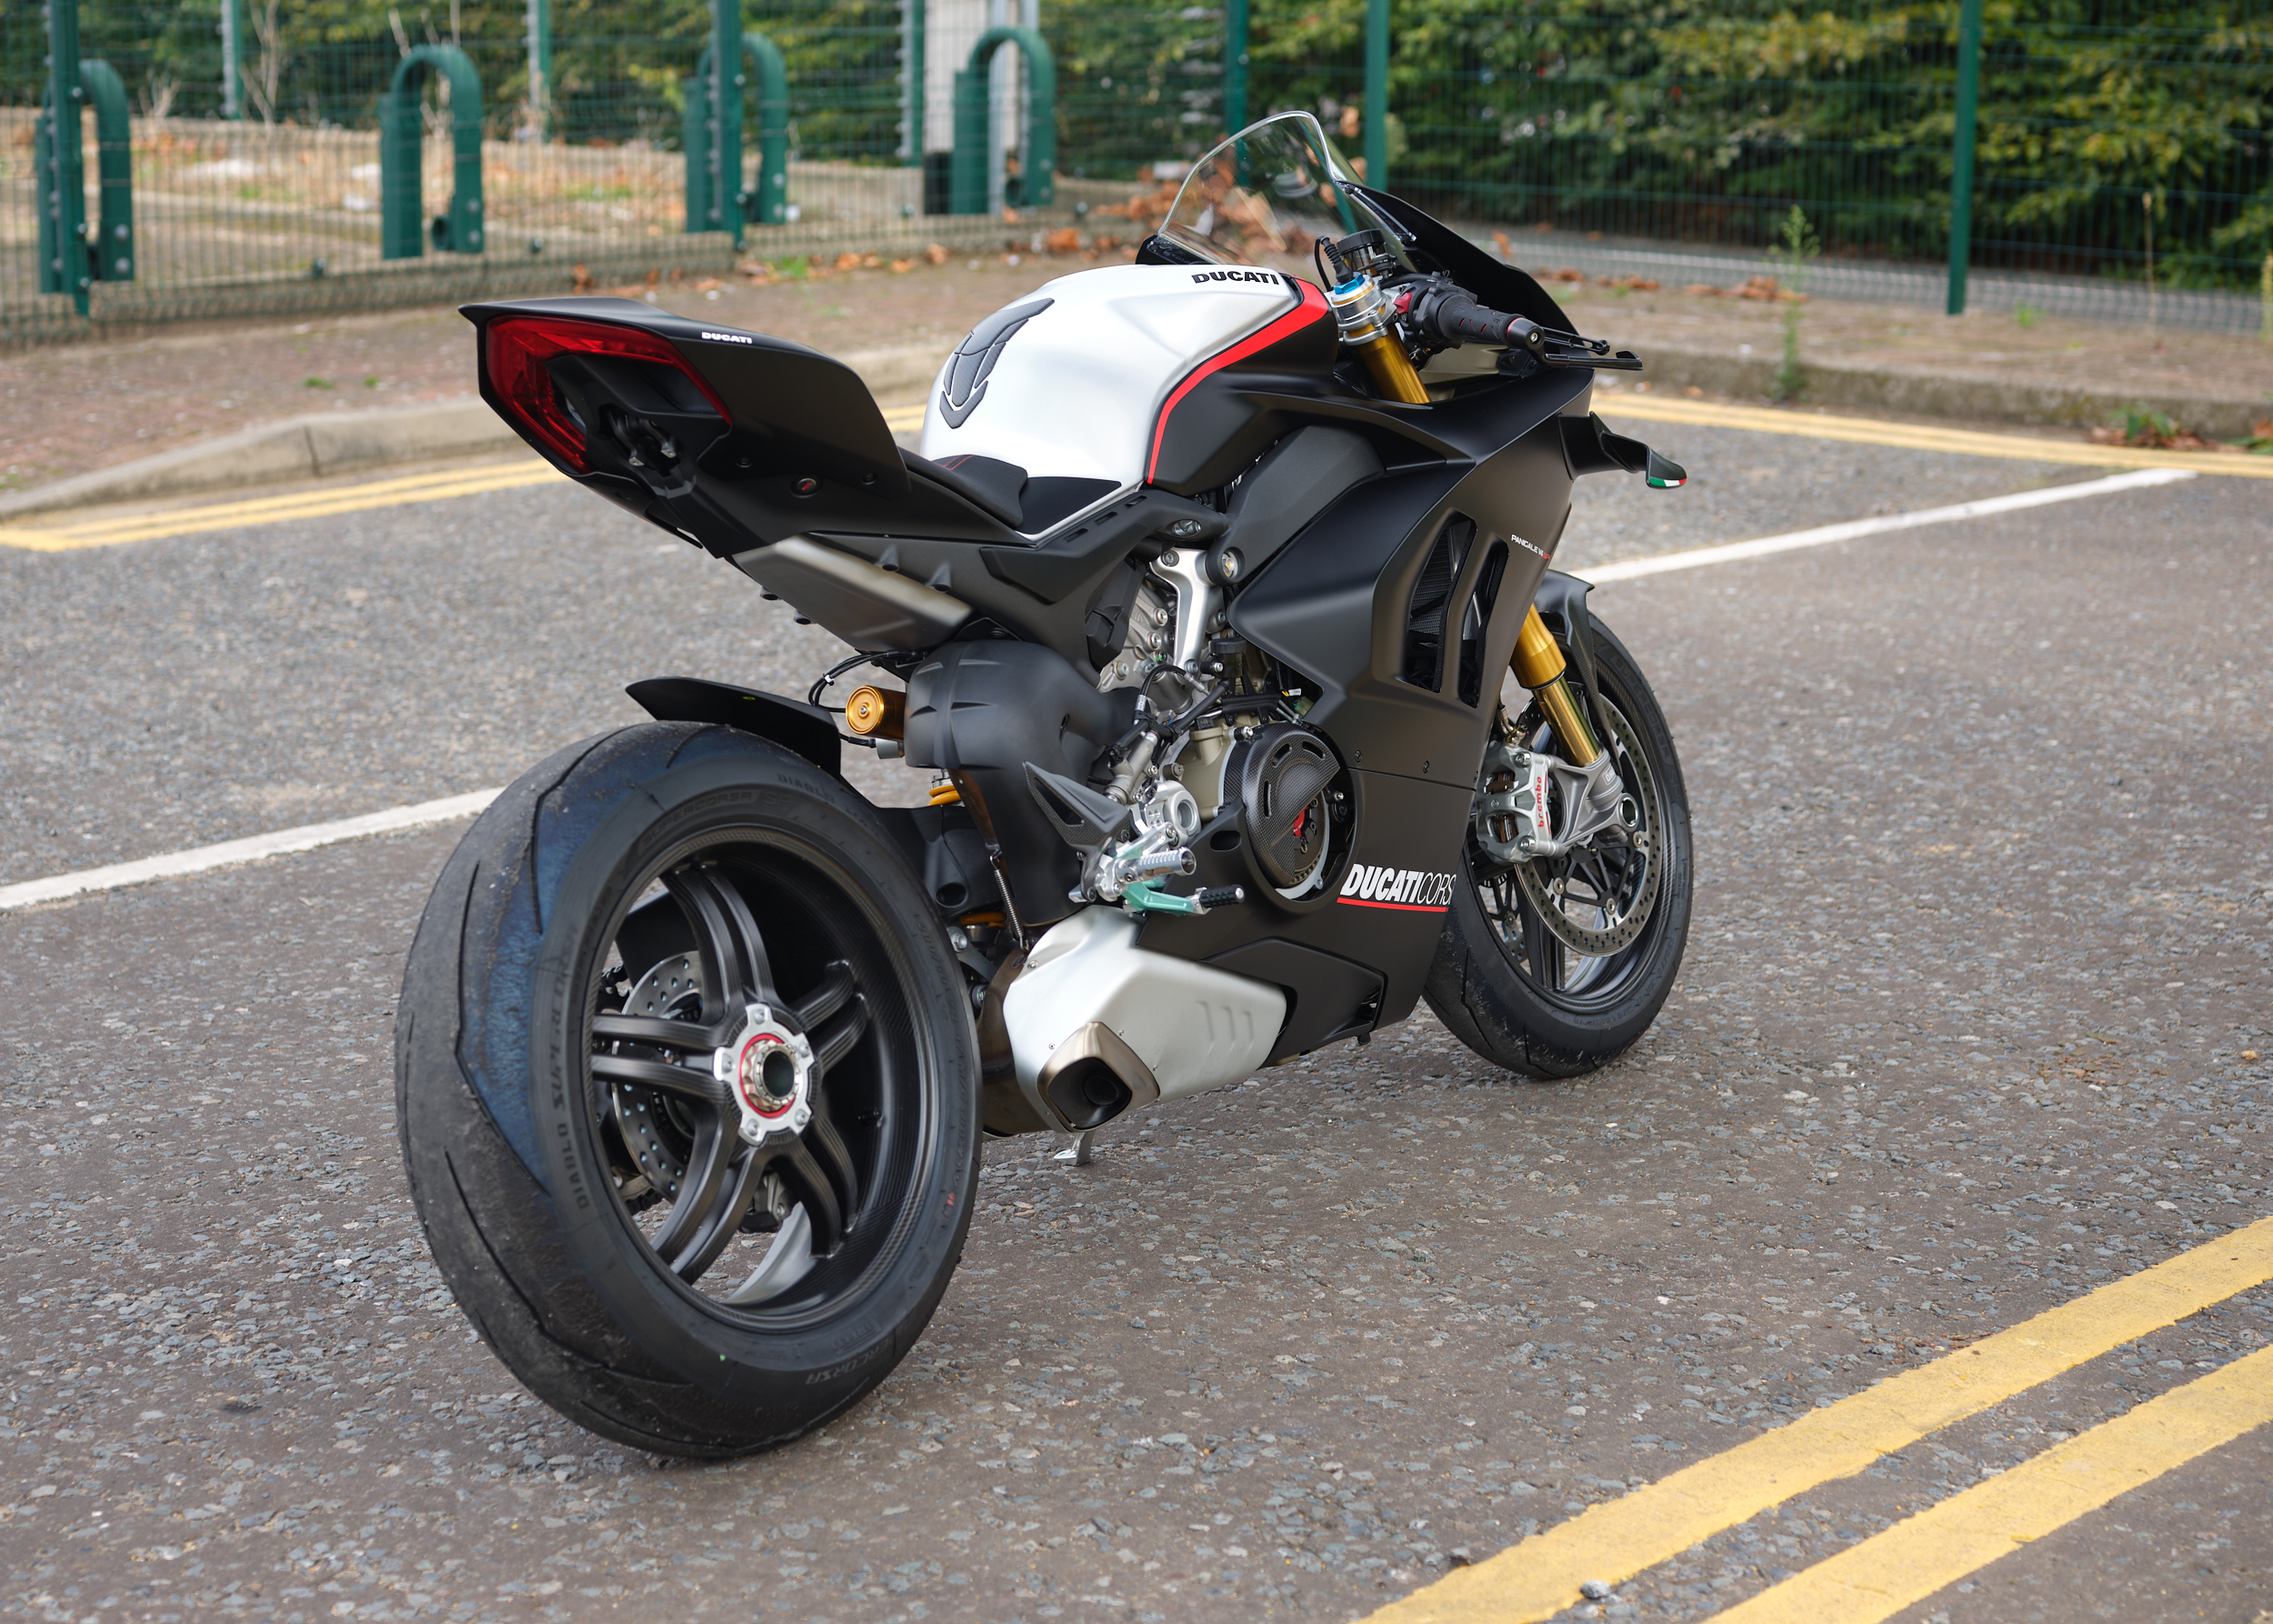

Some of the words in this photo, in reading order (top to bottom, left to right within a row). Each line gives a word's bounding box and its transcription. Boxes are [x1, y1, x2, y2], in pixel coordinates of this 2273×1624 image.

[1191, 271, 1280, 285] DUCATI
[701, 331, 753, 344] DUCATI
[1535, 776, 1545, 828] brembo
[1339, 863, 1457, 906] DUCATICORS
[556, 1122, 590, 1210] DIABLO
[830, 1318, 883, 1357] PIRELLI
